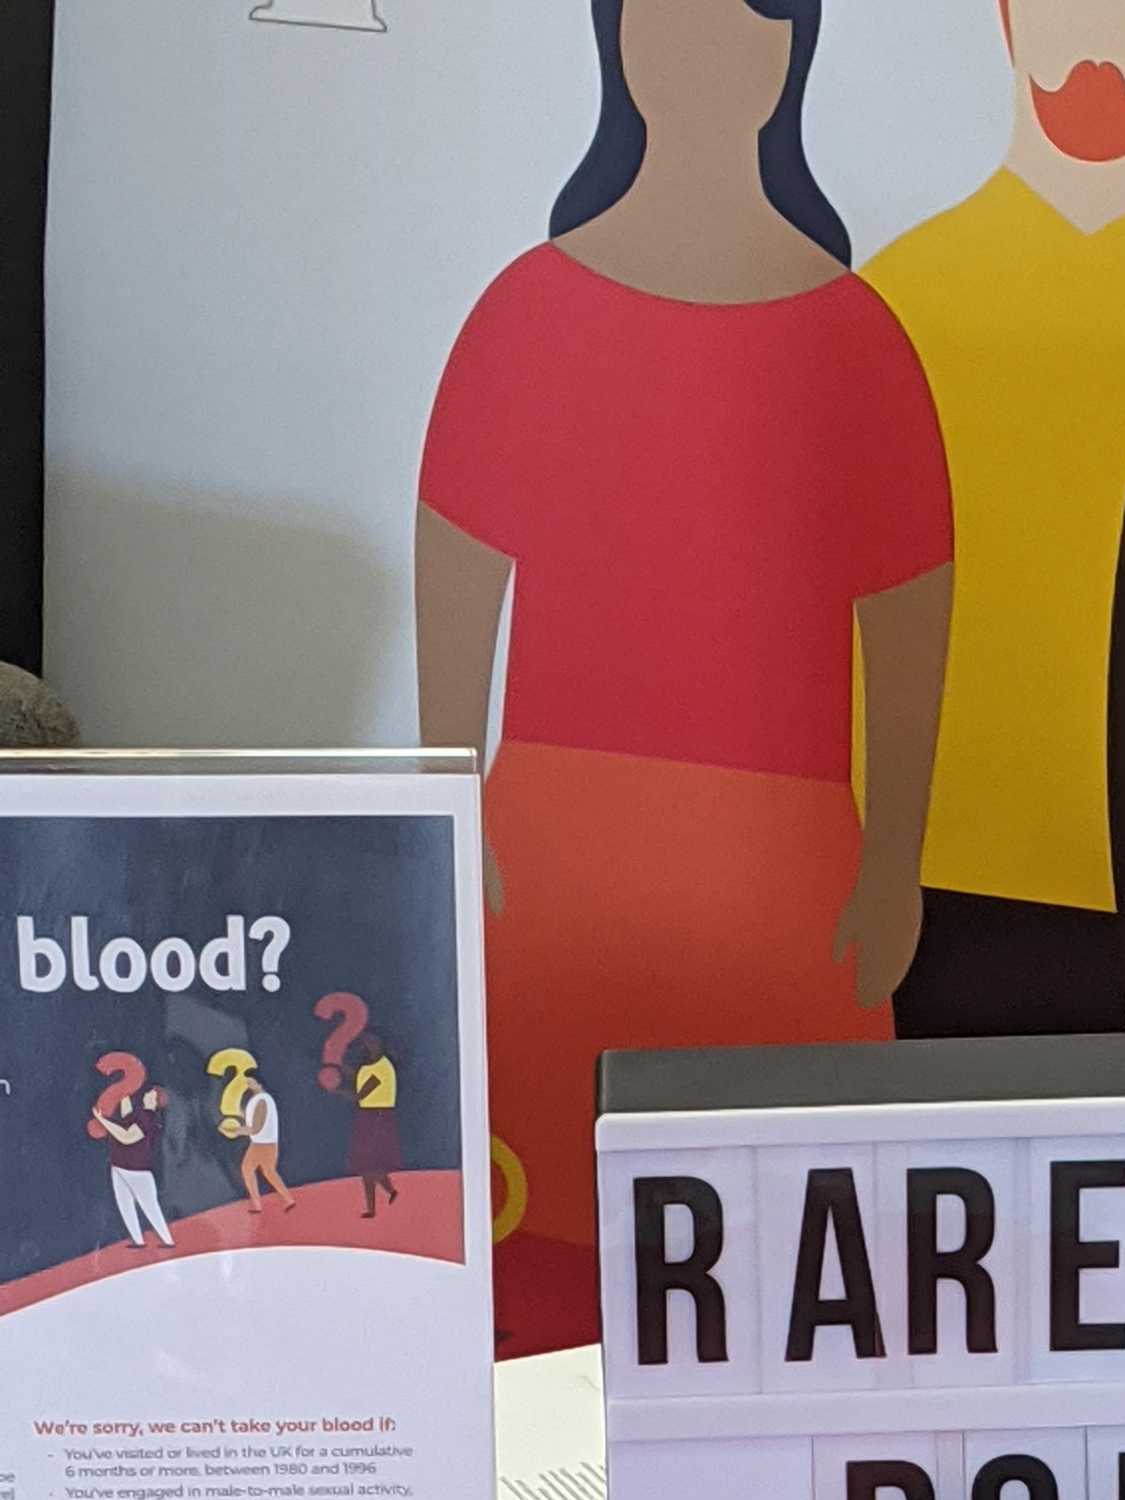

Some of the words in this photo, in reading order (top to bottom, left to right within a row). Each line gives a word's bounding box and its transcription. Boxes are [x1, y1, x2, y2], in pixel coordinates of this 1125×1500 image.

[16, 914, 291, 993] blood?
[34, 1419, 87, 1435] We're
[93, 1422, 143, 1437] sorry,
[149, 1422, 175, 1433] we
[181, 1418, 226, 1433] can't
[231, 1418, 270, 1432] take
[276, 1421, 316, 1436] your
[322, 1417, 373, 1431] blood
[65, 1447, 112, 1460] You've
[116, 1447, 162, 1459] visited
[167, 1449, 181, 1459] or
[187, 1447, 220, 1458] lived
[224, 1448, 237, 1458] in
[242, 1446, 266, 1457] the
[270, 1447, 291, 1457] UK
[296, 1446, 314, 1457] for
[320, 1448, 327, 1456] a
[331, 1445, 413, 1457] cumulative
[65, 1466, 74, 1477] 6
[79, 1466, 136, 1477] months
[141, 1466, 155, 1477] or
[205, 1464, 269, 1476] between
[274, 1464, 307, 1474] 1980
[311, 1463, 339, 1474] and
[344, 1462, 376, 1474] 1996
[66, 1487, 113, 1499] You've
[118, 1485, 182, 1500] engaged
[189, 1486, 200, 1497] in
[206, 1485, 304, 1496] male-to-male
[309, 1483, 354, 1496] sexual
